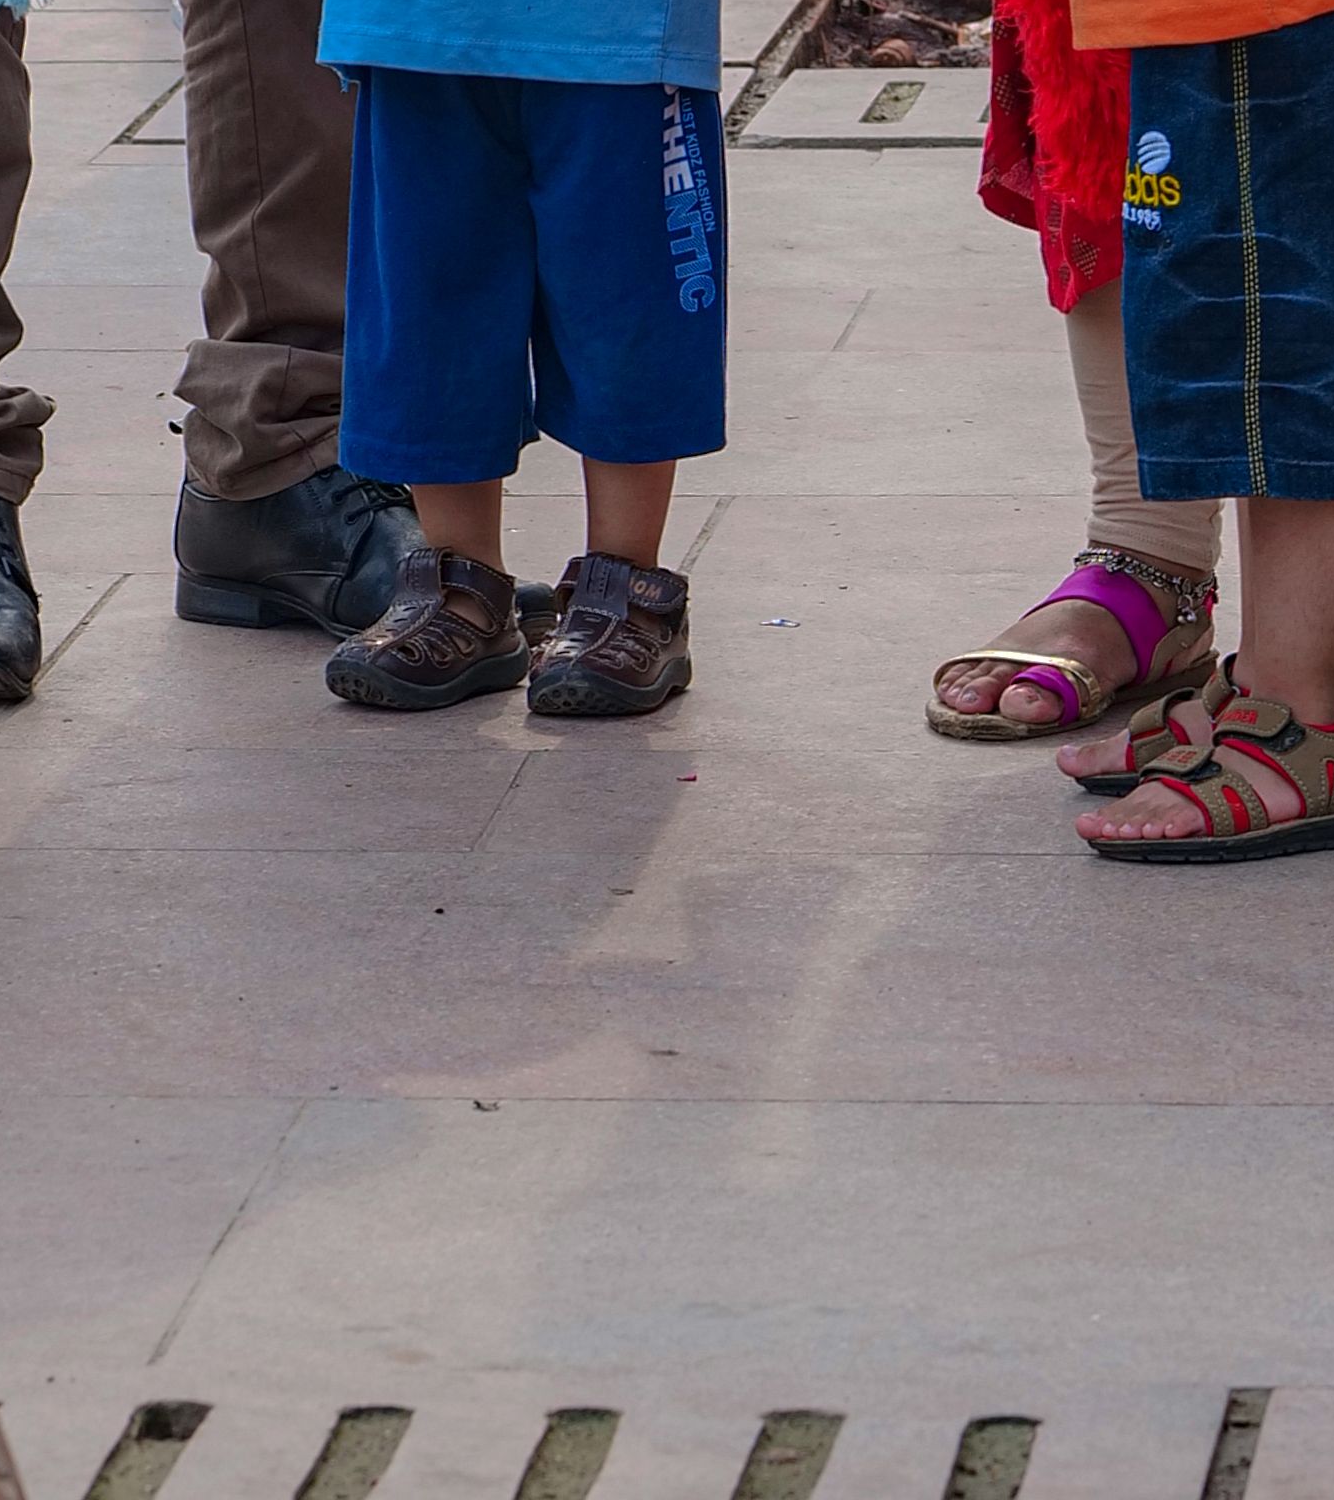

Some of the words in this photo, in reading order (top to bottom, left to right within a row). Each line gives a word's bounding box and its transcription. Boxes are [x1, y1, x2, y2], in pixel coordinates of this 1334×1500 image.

[681, 97, 696, 129] JUST
[685, 133, 703, 167] KIDZ
[693, 169, 716, 233] FASHION
